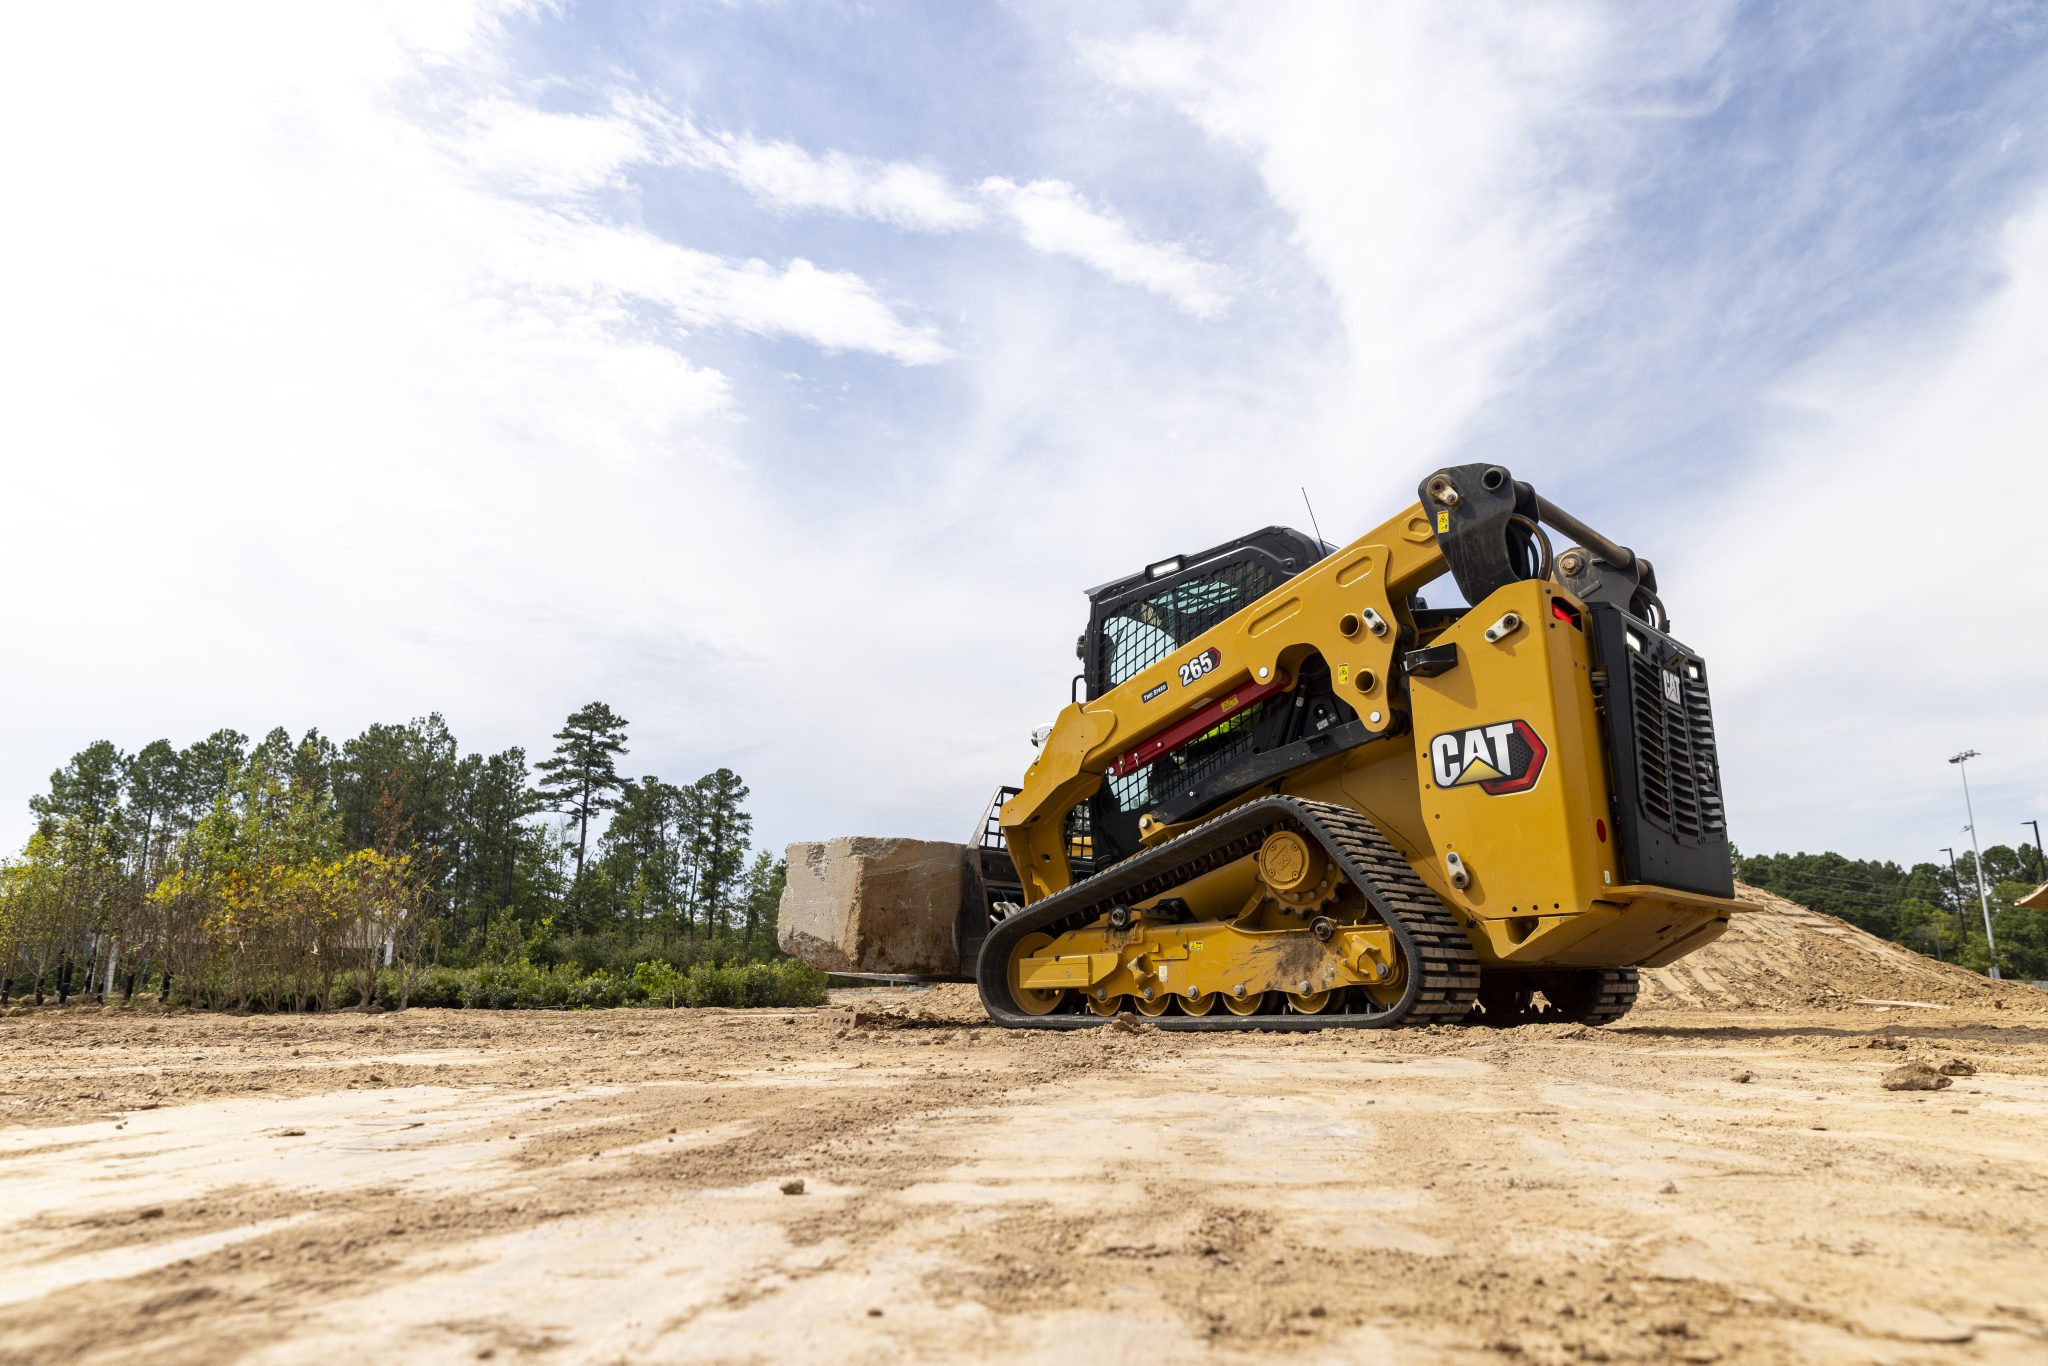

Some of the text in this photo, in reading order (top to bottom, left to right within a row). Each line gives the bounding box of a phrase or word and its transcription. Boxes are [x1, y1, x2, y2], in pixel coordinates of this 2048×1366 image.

[1179, 651, 1213, 686] 265
[1662, 669, 1680, 705] CAT
[1431, 722, 1514, 787] CAT
